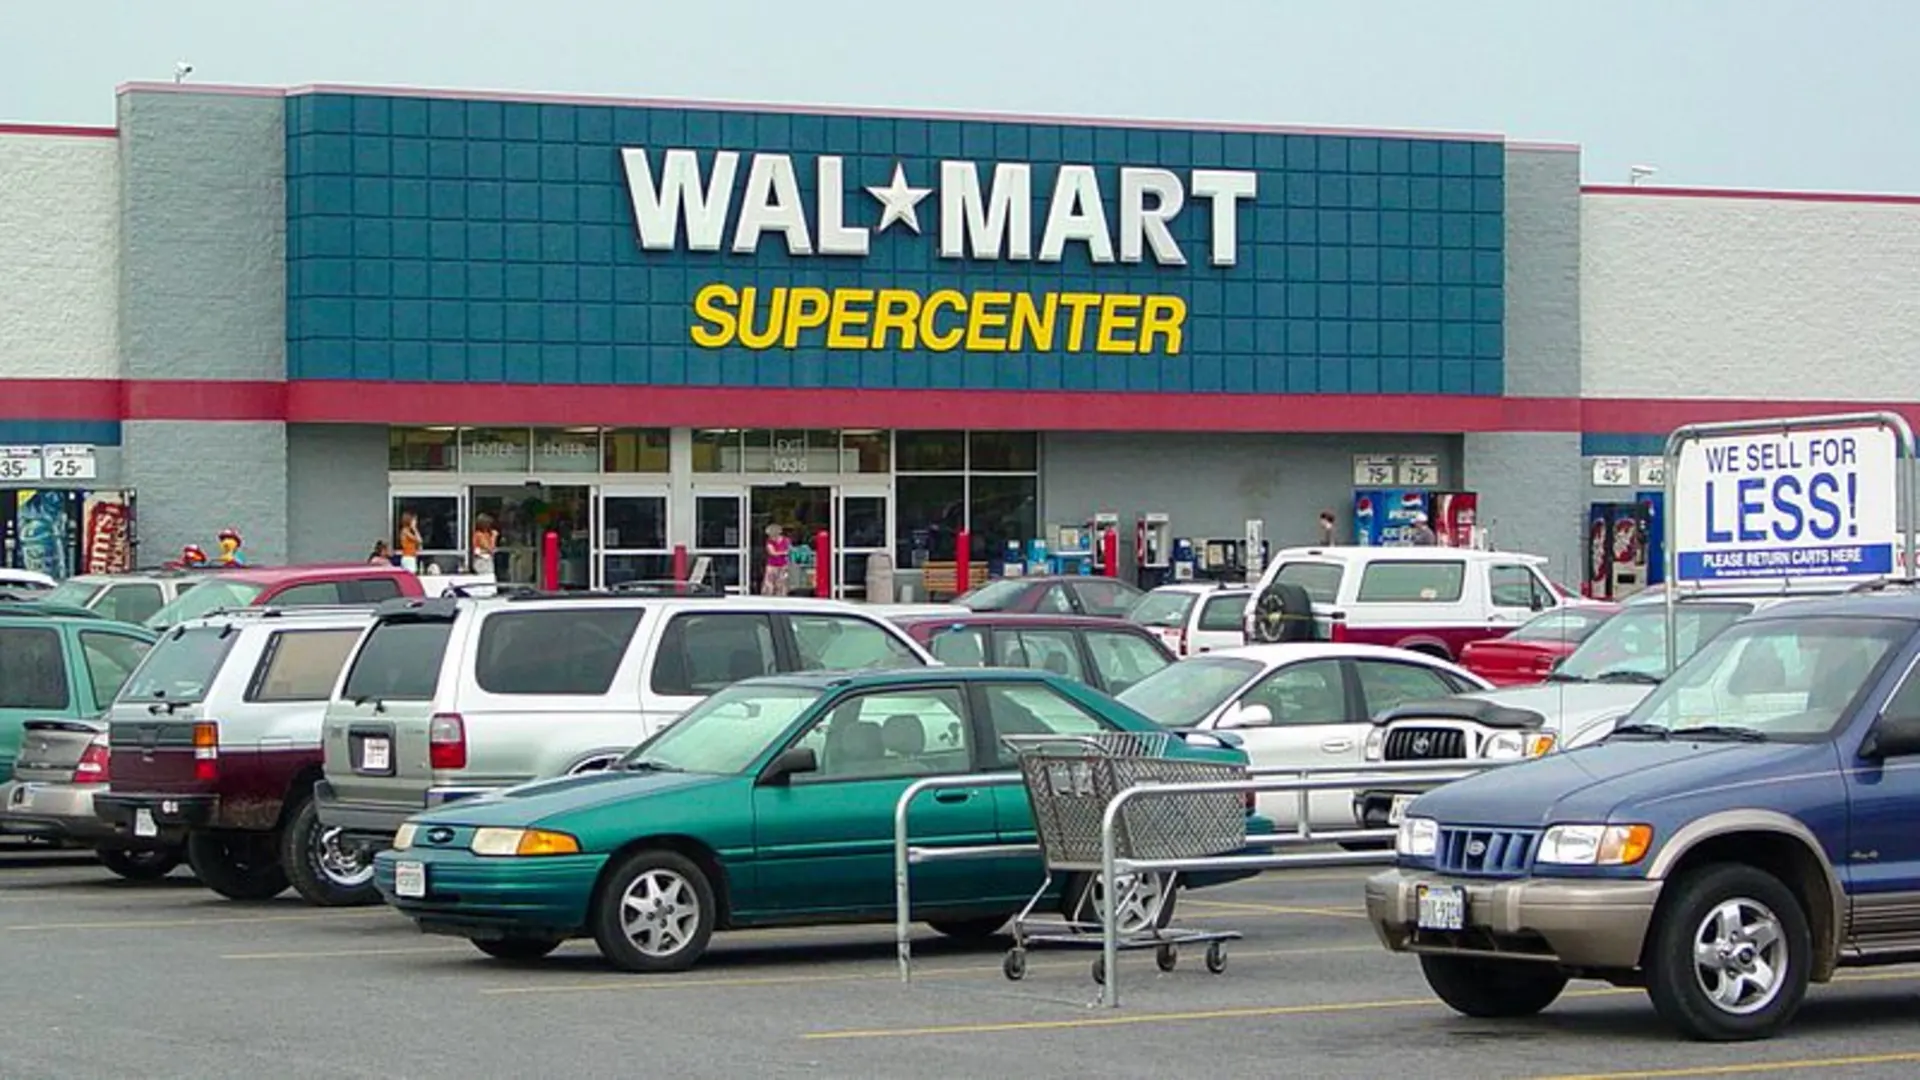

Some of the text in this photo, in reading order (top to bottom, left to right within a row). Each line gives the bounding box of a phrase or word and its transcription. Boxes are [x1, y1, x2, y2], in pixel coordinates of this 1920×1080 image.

[621, 148, 1257, 266] WAL MART
[690, 284, 1188, 355] SUPERCENTER
[1706, 438, 1857, 473] WE SELL FOR
[1705, 472, 1857, 543] LESS!
[1703, 547, 1863, 567] PLEASE RETURN CARTS HERE
